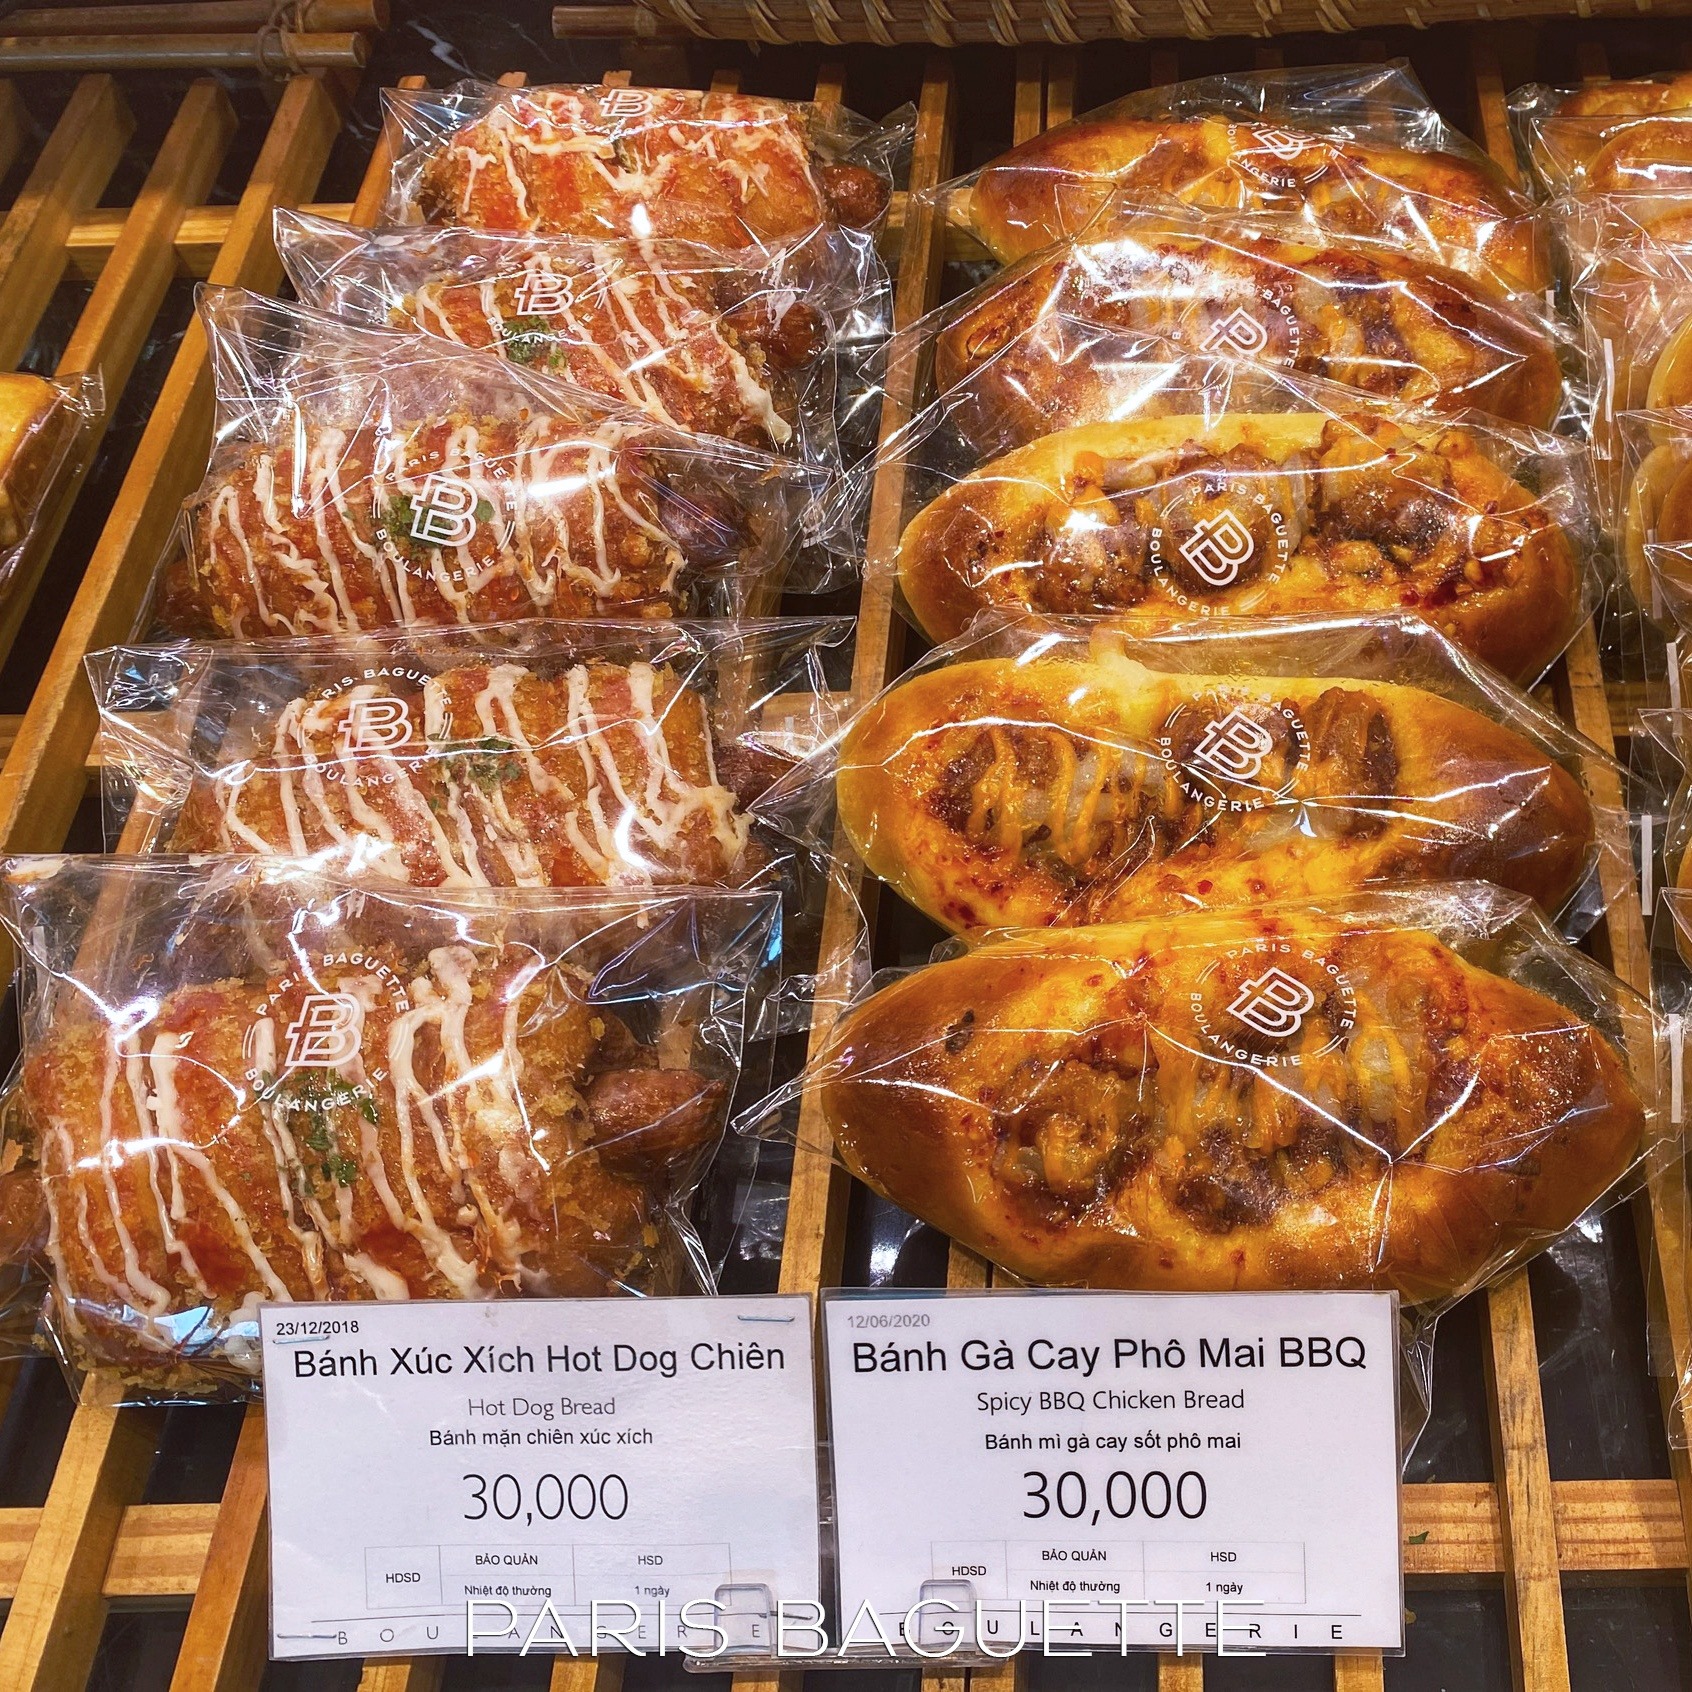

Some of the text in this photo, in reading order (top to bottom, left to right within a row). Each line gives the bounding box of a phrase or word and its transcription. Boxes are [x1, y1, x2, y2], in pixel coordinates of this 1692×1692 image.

[1262, 288, 1300, 369] BAGUETTE
[1191, 482, 1289, 585] PARIS BAGUETTE
[375, 528, 495, 583] BOULANGERIE
[1149, 527, 1231, 617] BOULANGERIE
[363, 667, 453, 706] BAGUETTE
[1259, 692, 1311, 773] BAGUETTE
[1160, 737, 1265, 812] BOULANGERIE
[322, 951, 411, 1014] BAGUETTE
[1225, 943, 1358, 1031] PARIS BAGUETTE
[1190, 992, 1304, 1068] BOULANGERIE
[244, 1066, 388, 1113] BOULANGERIE
[276, 1320, 360, 1336] 23/12/2018
[847, 1314, 931, 1329] 12/06/2020
[294, 1341, 786, 1379] Bánh Xúc Xích Hot Dog Chiên
[852, 1335, 1367, 1378] Bánh Gà Cay Phô Mai BBQ
[467, 1396, 616, 1421] Hot Dog Bread
[976, 1388, 1246, 1416] Spicy BBQ Chicken Bread
[429, 1427, 654, 1449] Bánh mặn chiên xúc xích
[984, 1429, 1242, 1453] Bánh mì gà cay sốt phô mai
[462, 1473, 629, 1528] 30,000
[1022, 1470, 1208, 1527] 30,000
[475, 1552, 539, 1567] BẢO QUẢN
[637, 1555, 664, 1566] HSD
[1041, 1548, 1108, 1562] BẢO QUẢN
[1210, 1551, 1238, 1563] HSD
[385, 1572, 422, 1584] HDSD
[951, 1565, 988, 1577] HDSD
[463, 1584, 552, 1598] Nhiệt độ thường
[634, 1585, 671, 1598] 1 ngày
[1029, 1580, 1121, 1594] Nhiệt độ thường
[1205, 1582, 1244, 1595] 1 ngày
